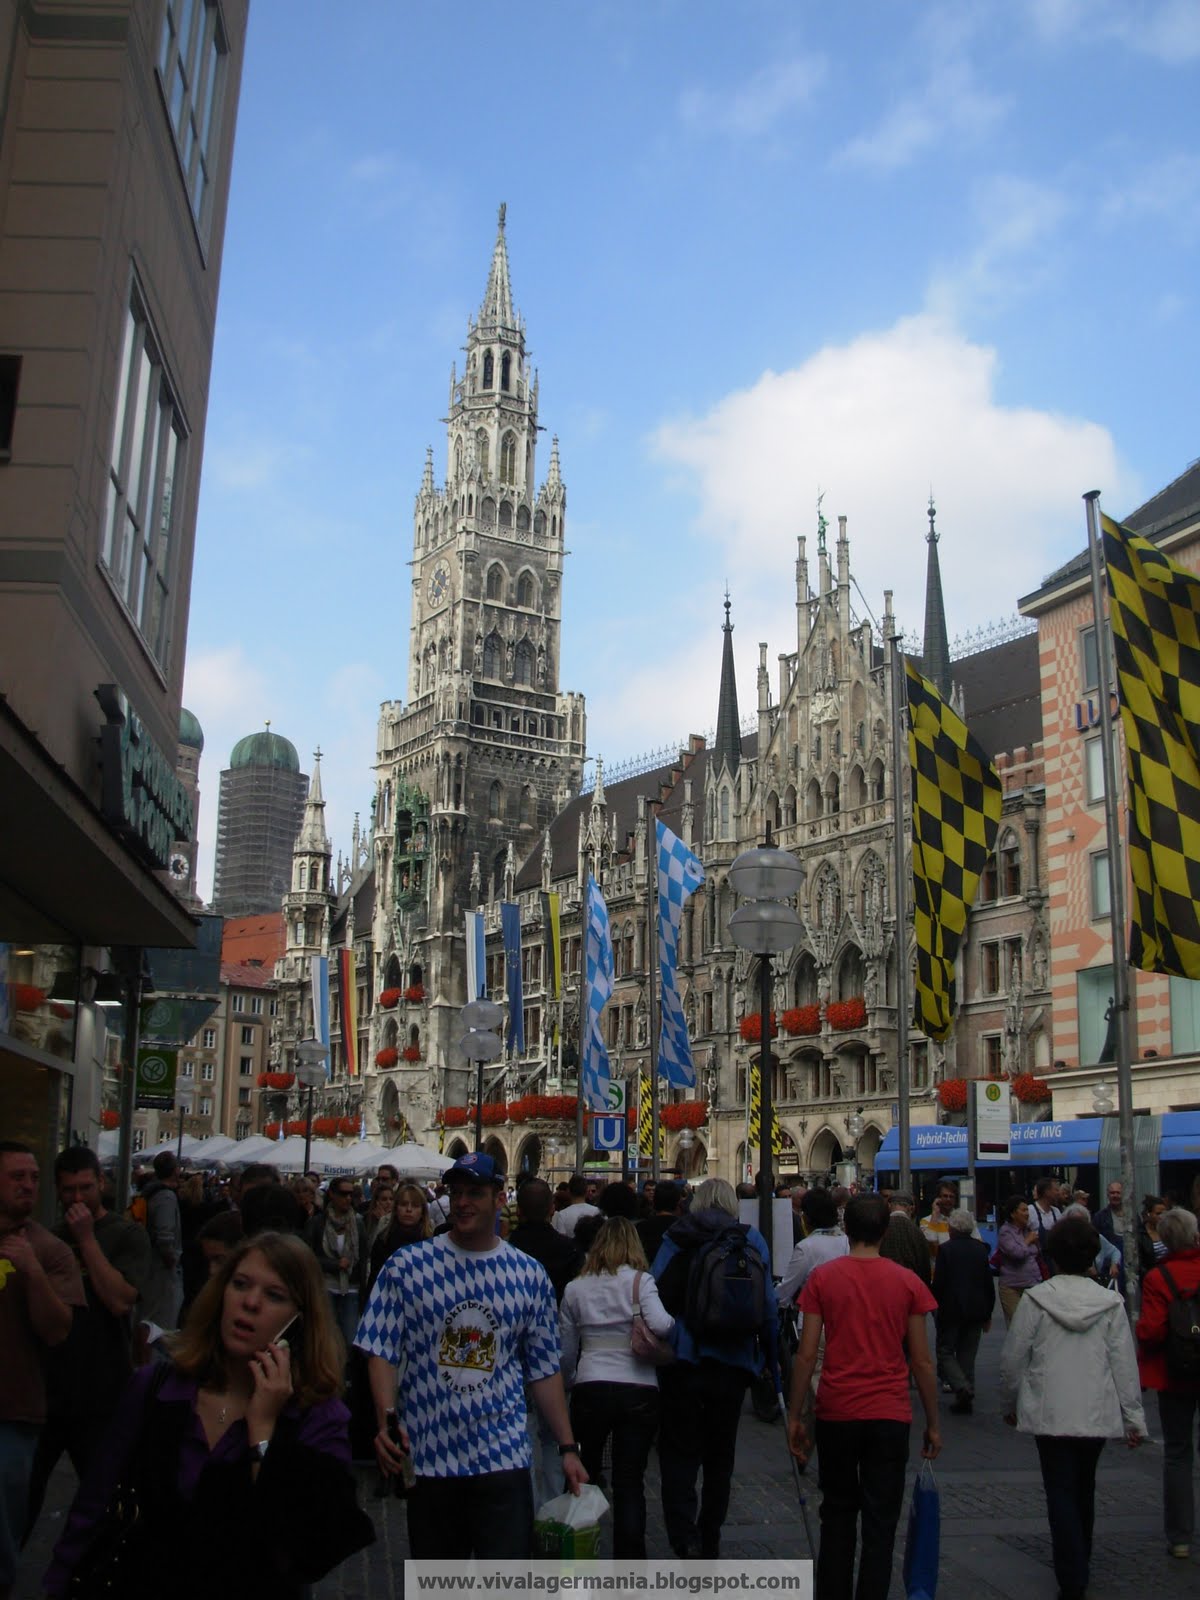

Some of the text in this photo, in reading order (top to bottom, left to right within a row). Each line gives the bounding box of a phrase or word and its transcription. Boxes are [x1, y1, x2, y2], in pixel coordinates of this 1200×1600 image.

[598, 1119, 621, 1148] U
[916, 1131, 968, 1148] Hybrid-Techn
[1024, 1126, 1038, 1139] der
[1040, 1124, 1062, 1138] MVG
[445, 1300, 499, 1331] Oktoberfest
